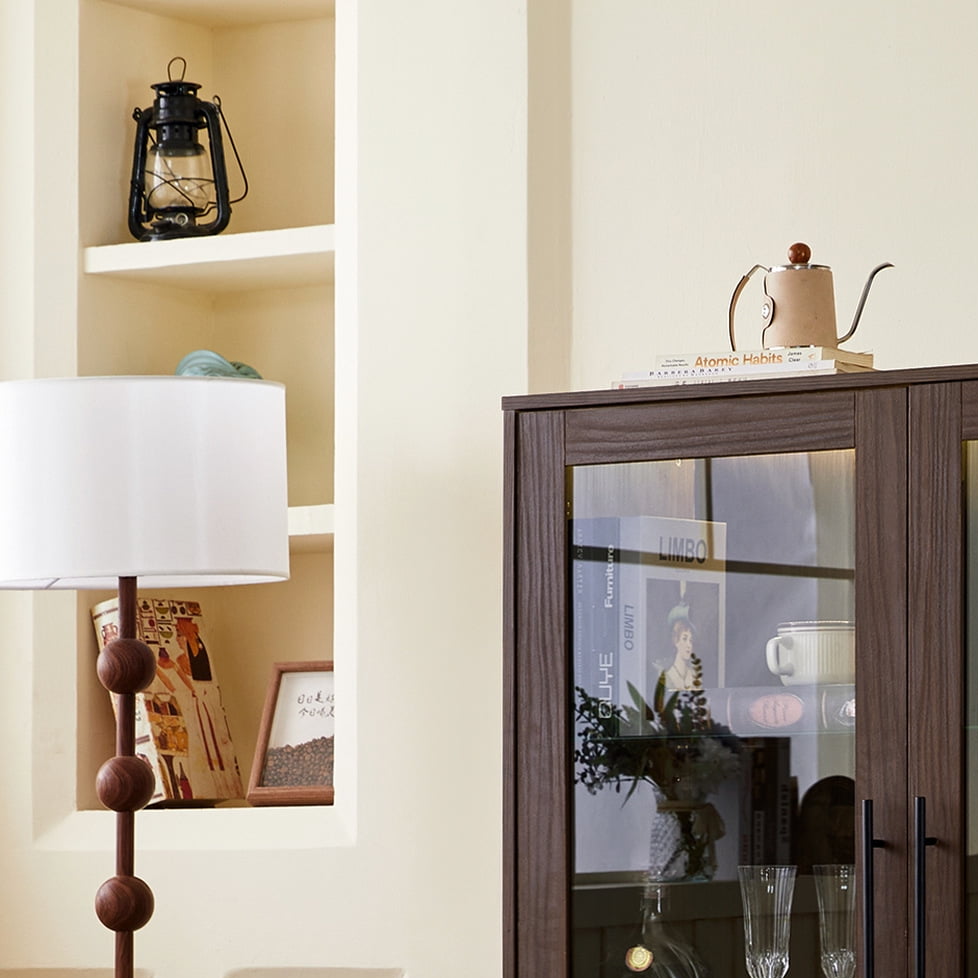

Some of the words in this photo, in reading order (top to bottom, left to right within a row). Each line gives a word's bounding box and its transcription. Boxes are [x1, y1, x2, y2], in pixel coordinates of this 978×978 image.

[695, 354, 739, 368] Atomic
[743, 352, 784, 366] Habits
[658, 535, 707, 564] LIMBO
[604, 544, 616, 609] Furniture
[623, 604, 635, 651] LIMBO
